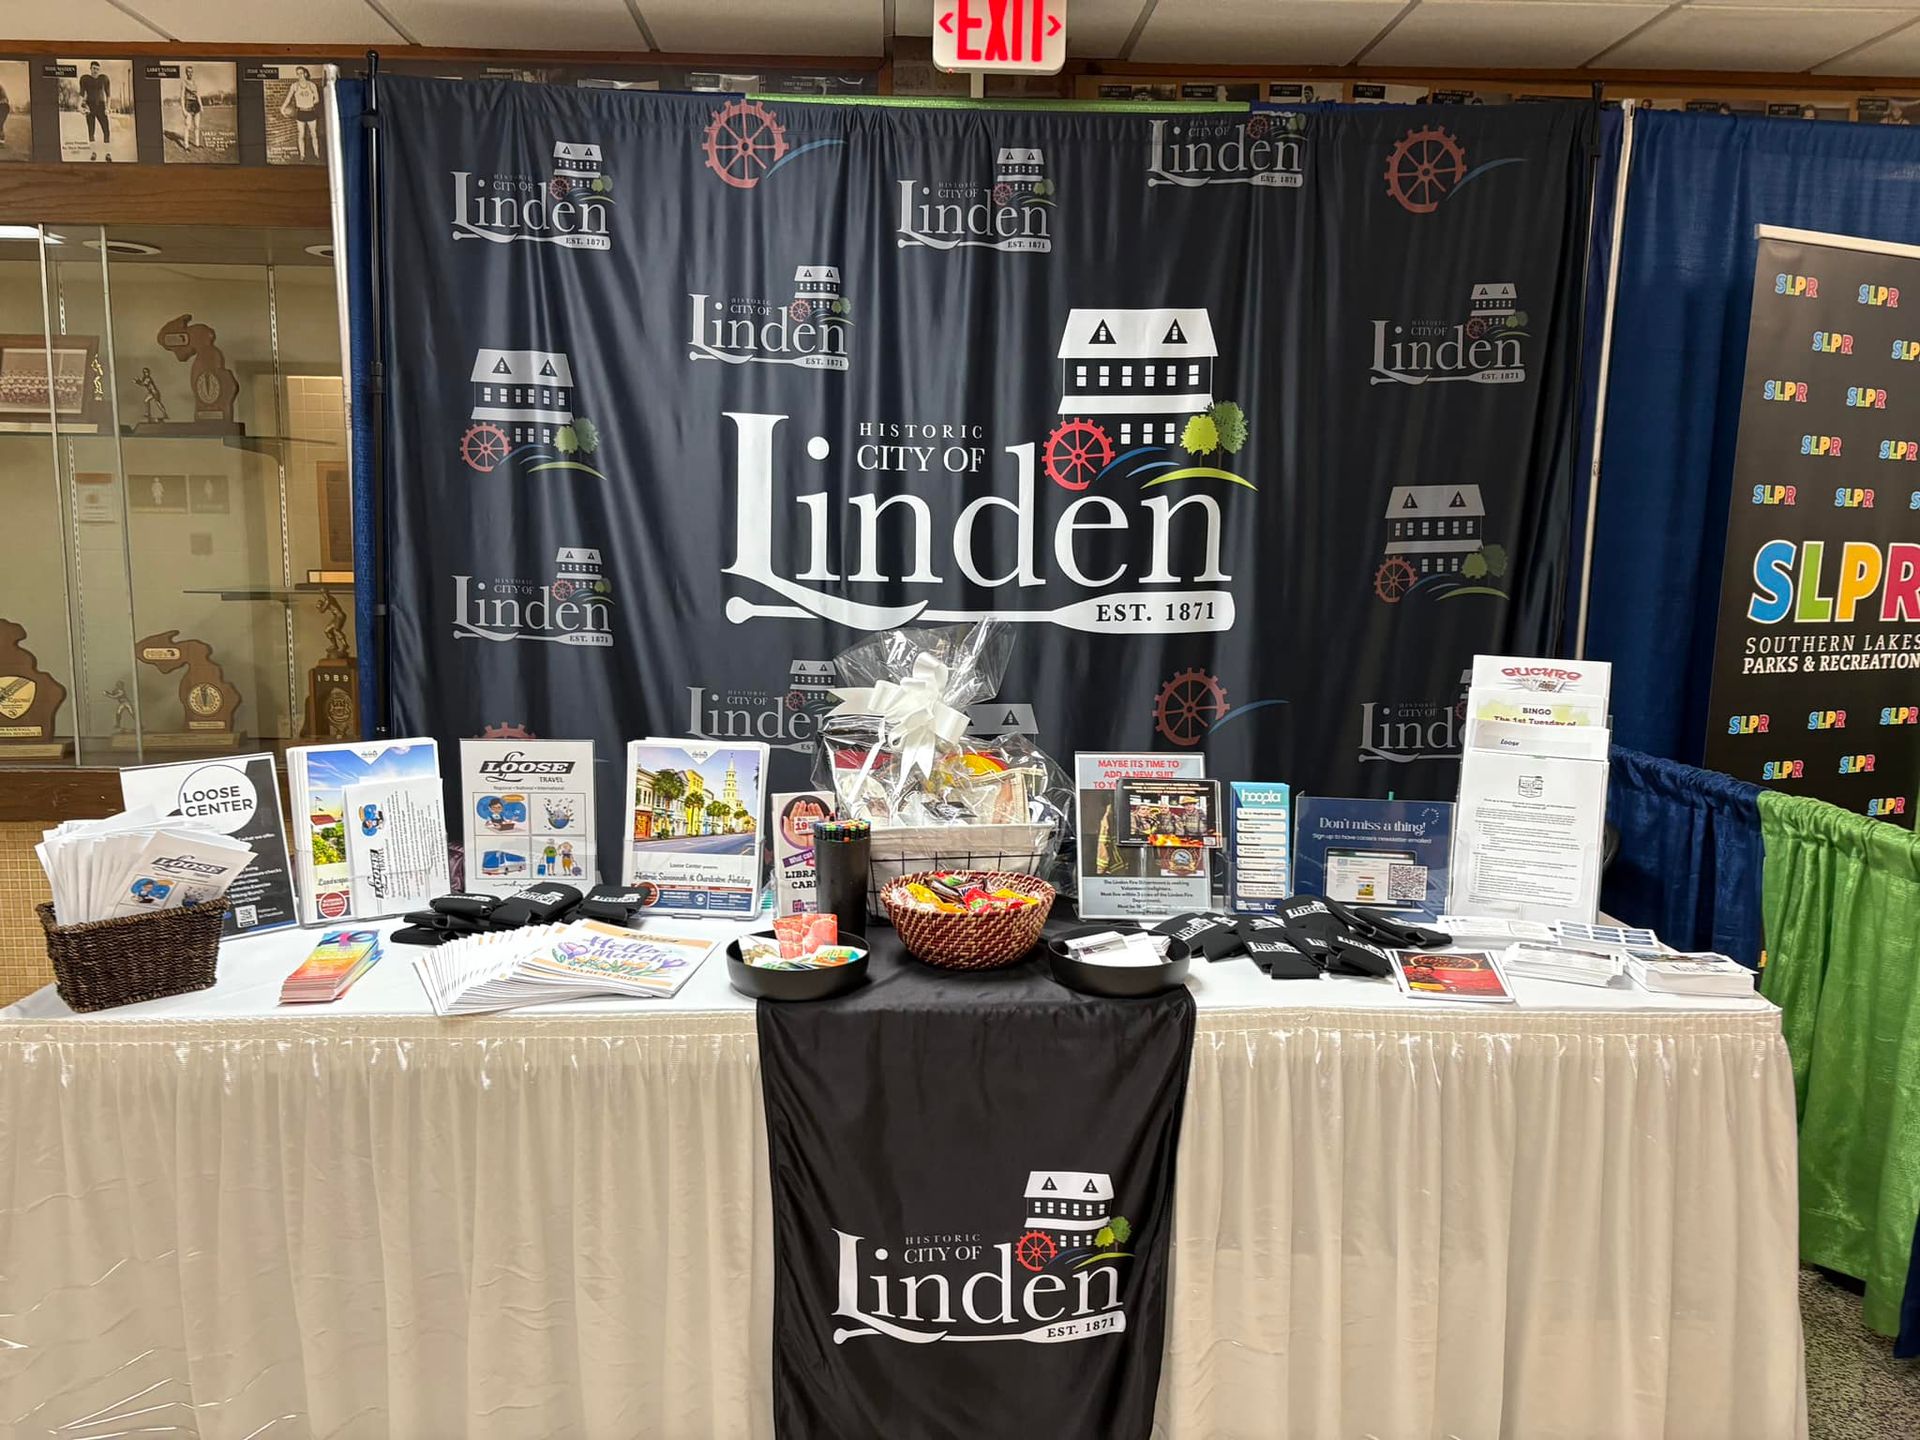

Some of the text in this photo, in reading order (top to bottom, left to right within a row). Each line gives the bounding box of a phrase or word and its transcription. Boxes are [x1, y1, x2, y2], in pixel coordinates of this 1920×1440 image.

[956, 0, 1043, 62] EXIT
[1188, 126, 1230, 136] CITY OF
[1147, 120, 1302, 187] Linden
[493, 180, 534, 192] CITY OF
[938, 188, 978, 198] CITY OF
[450, 171, 610, 244] Linden
[896, 180, 1050, 250] Linden
[1775, 273, 1818, 298] SLPR
[1858, 283, 1900, 308] SLPR
[730, 304, 773, 316] CITY OF
[688, 294, 848, 364] Linden
[1410, 326, 1448, 336] CITY OF
[1812, 330, 1854, 354] SLPR
[1891, 339, 1920, 360] SLP
[1370, 320, 1525, 386] Linden
[1764, 380, 1808, 404] SLPR
[1846, 386, 1888, 409] SLPR
[859, 422, 984, 439] HISTORIC
[1800, 434, 1842, 456] SLPR
[1878, 440, 1919, 462] SLPR
[856, 444, 986, 473] CITY OF
[1752, 484, 1798, 506] SLPR
[1834, 487, 1874, 508] SLPR
[720, 412, 1233, 630] Linden
[494, 585, 534, 595] CITY OF
[1746, 538, 1920, 624] SLPR
[452, 575, 612, 642] Linden
[1095, 602, 1217, 623] EST. 1871
[1744, 633, 1920, 655] SOUTHERN LAKES
[1742, 652, 1920, 674] PARKS & RECREATION
[726, 696, 768, 706] CITY OF
[1522, 707, 1552, 716] BINGO
[1398, 709, 1422, 717] CITY
[1528, 718, 1565, 726] Tuesday
[1807, 710, 1847, 730] SLPR
[1879, 706, 1919, 726] SLPR
[1358, 702, 1466, 762] Lind
[1728, 714, 1770, 736] SLPR
[484, 761, 570, 773] LOOSE
[1098, 760, 1180, 768] MAYBE ITS TIME TO
[1104, 770, 1122, 778] ADD
[1762, 760, 1804, 781] SLPR
[1838, 754, 1876, 774] SLPR
[182, 784, 242, 804] LOOSE
[1093, 781, 1106, 789] TO
[185, 797, 254, 818] CENTER
[1241, 789, 1281, 805] hoopla
[1867, 796, 1906, 816] SLPR
[1320, 817, 1426, 837] Don't miss a thing!
[785, 870, 816, 878] LIBRA
[904, 1234, 982, 1246] HISTORIC
[904, 1245, 982, 1264] CITY OF
[830, 1228, 1124, 1344] Linden
[1047, 1316, 1116, 1339] EST. 1871
